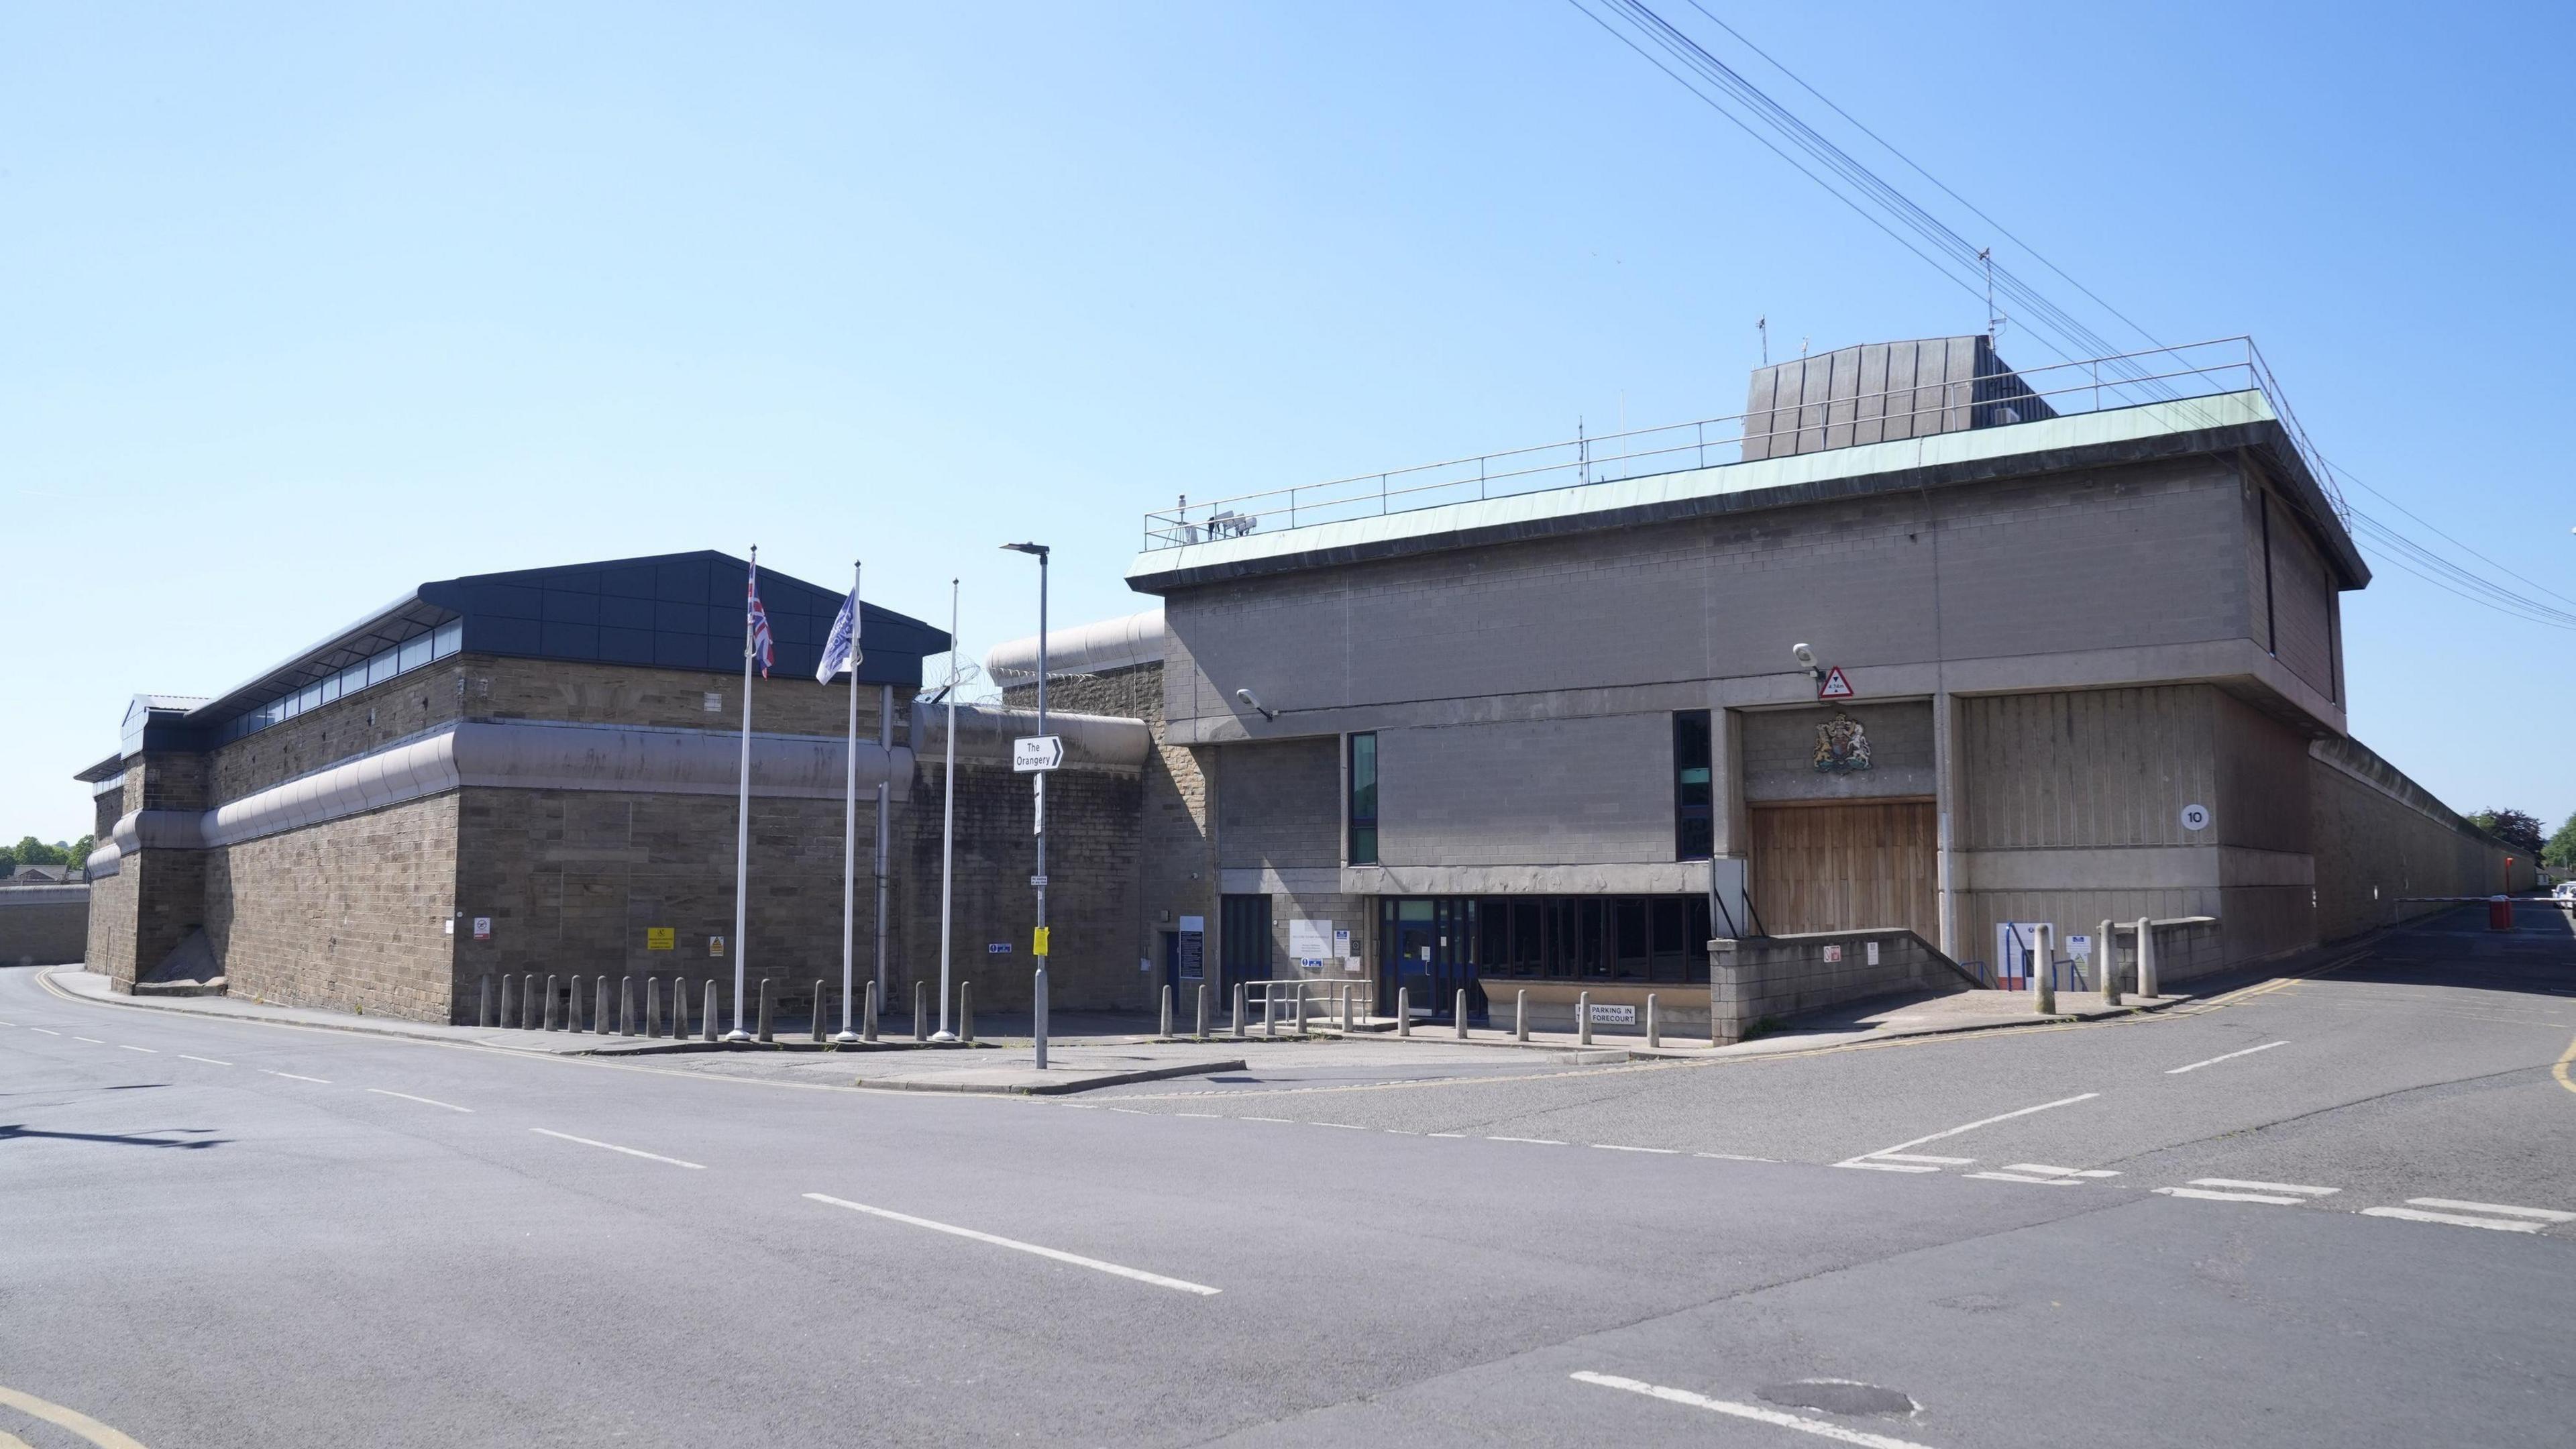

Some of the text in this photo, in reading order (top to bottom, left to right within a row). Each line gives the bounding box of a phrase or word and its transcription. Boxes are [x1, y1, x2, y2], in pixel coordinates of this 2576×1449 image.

[1027, 743, 1040, 752] The
[1016, 756, 1051, 766] Orangery
[2188, 812, 2202, 822] 10
